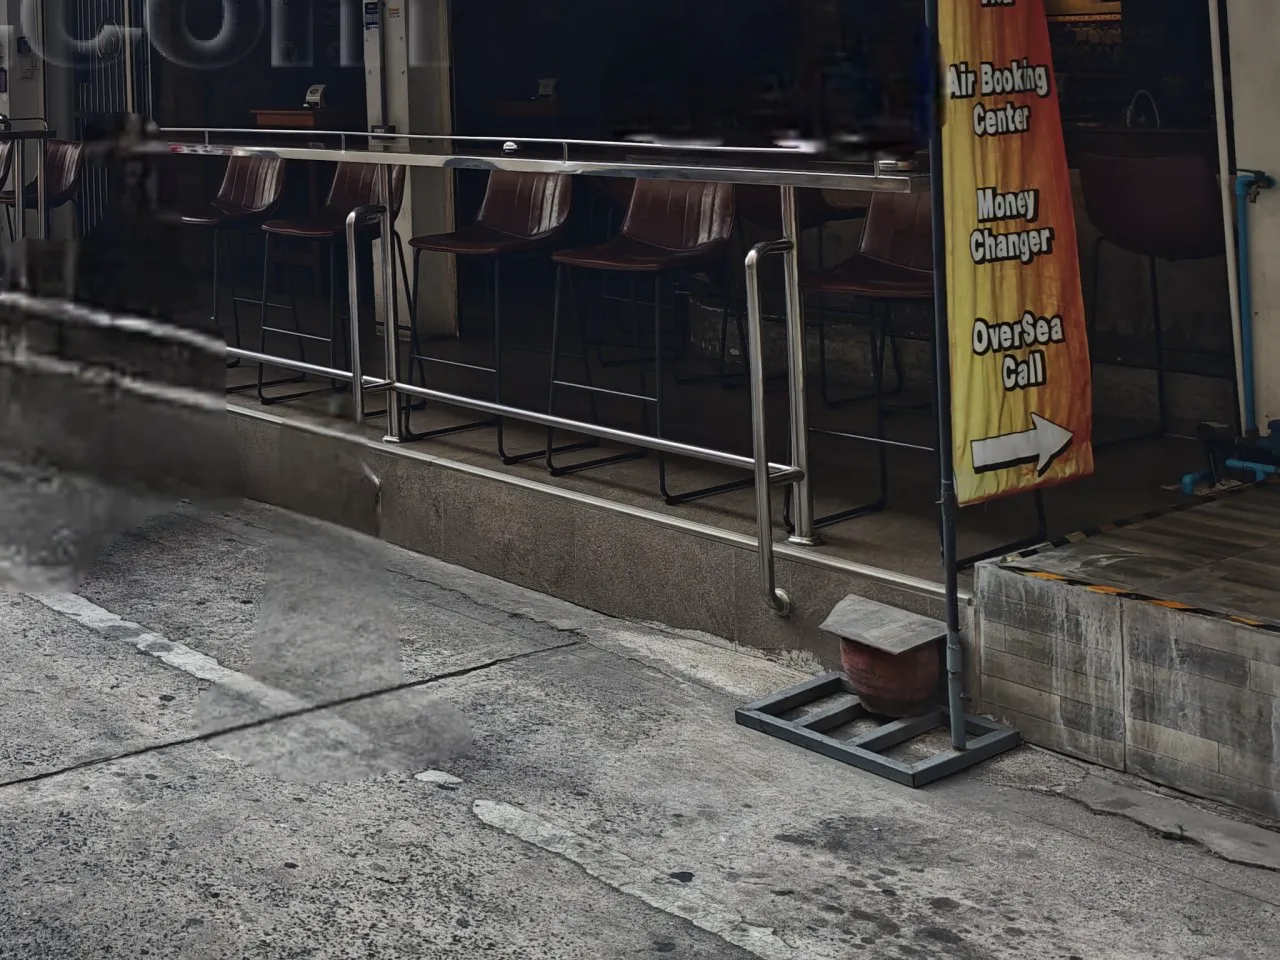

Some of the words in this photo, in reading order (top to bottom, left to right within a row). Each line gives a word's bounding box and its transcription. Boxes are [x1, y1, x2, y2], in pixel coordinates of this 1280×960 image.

[948, 60, 977, 100] Air
[980, 58, 1050, 98] Booking
[973, 101, 1032, 136] Center
[976, 186, 1039, 224] Money
[970, 227, 1055, 265] Changer
[972, 310, 1066, 356] OverSea
[1001, 348, 1046, 392] Call
